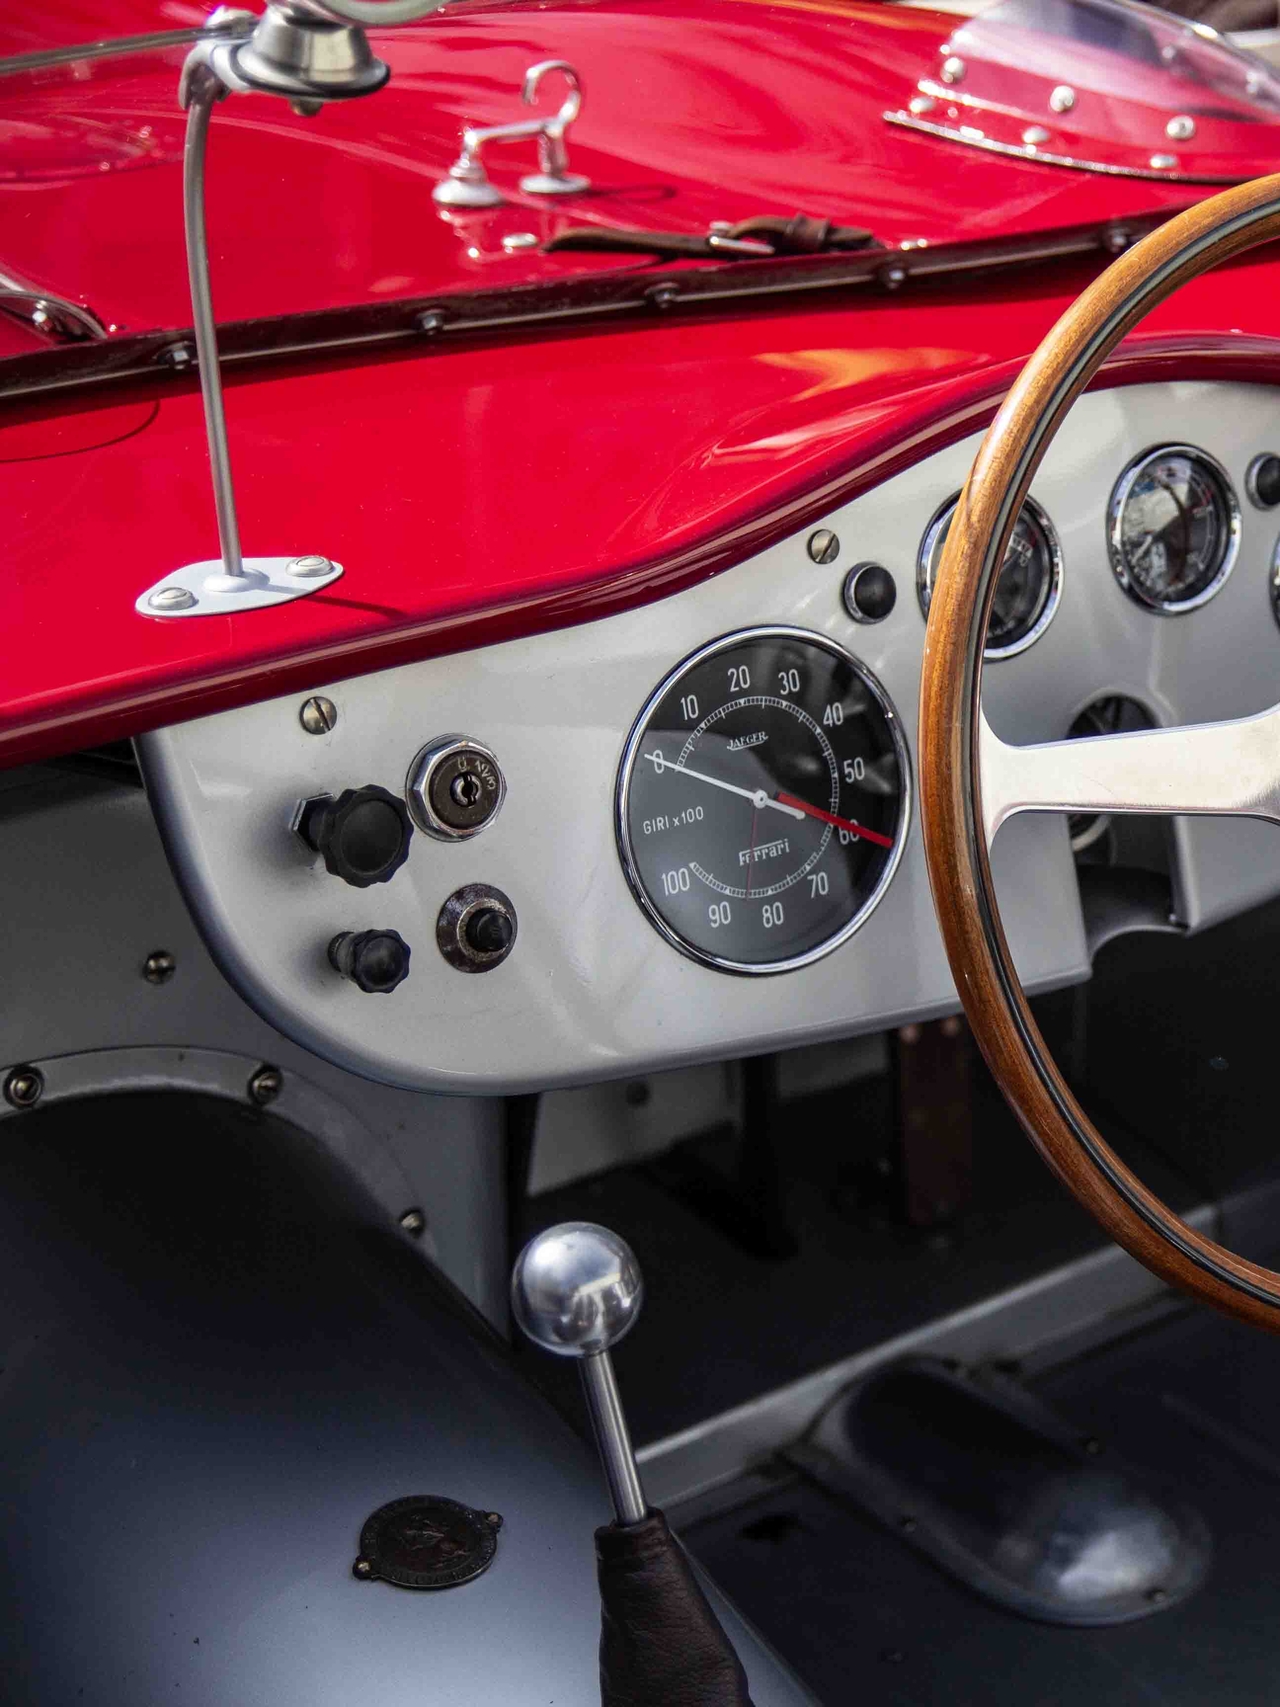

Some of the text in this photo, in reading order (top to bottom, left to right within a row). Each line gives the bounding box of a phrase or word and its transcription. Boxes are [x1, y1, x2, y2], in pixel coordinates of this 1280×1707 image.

[727, 665, 751, 692] 20
[778, 669, 800, 695] 30
[680, 694, 699, 720] 10
[823, 702, 843, 727] 40
[726, 731, 769, 751] JAEGER
[652, 749, 665, 774] 0
[843, 757, 865, 783] 50
[643, 815, 670, 835] GIRI
[738, 838, 790, 867] Ferrari
[661, 867, 690, 897] 100
[807, 871, 829, 899] 70
[708, 901, 731, 928] 90
[762, 901, 784, 928] 80
